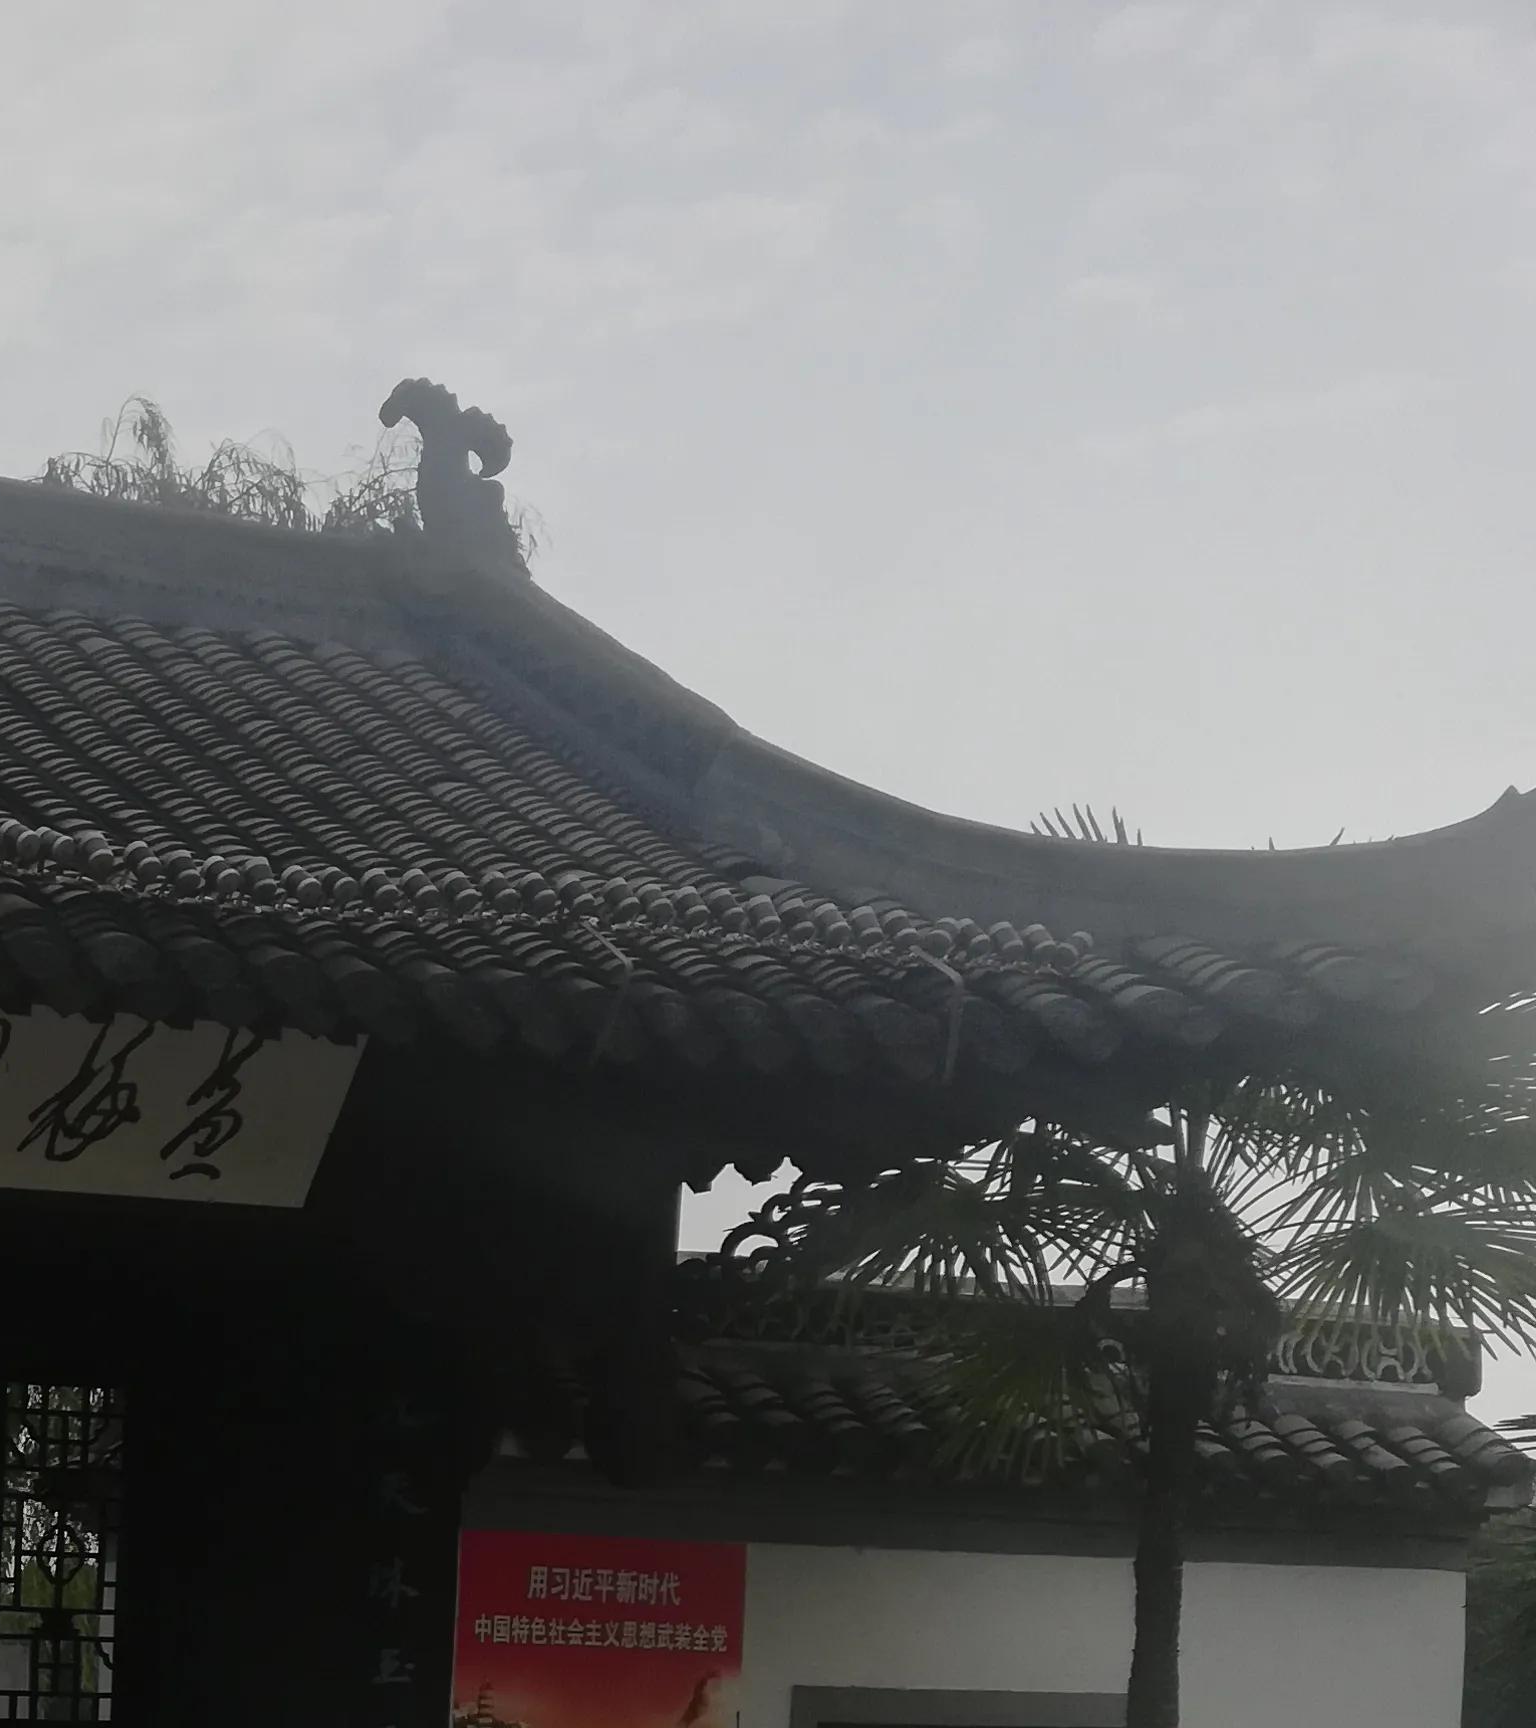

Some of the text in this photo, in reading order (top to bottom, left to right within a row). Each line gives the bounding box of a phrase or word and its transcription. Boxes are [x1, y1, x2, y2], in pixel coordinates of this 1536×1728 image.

[527, 1566, 681, 1605] 用习近平新时代
[475, 1614, 728, 1652] 中国特色社会主义思想武装全党
